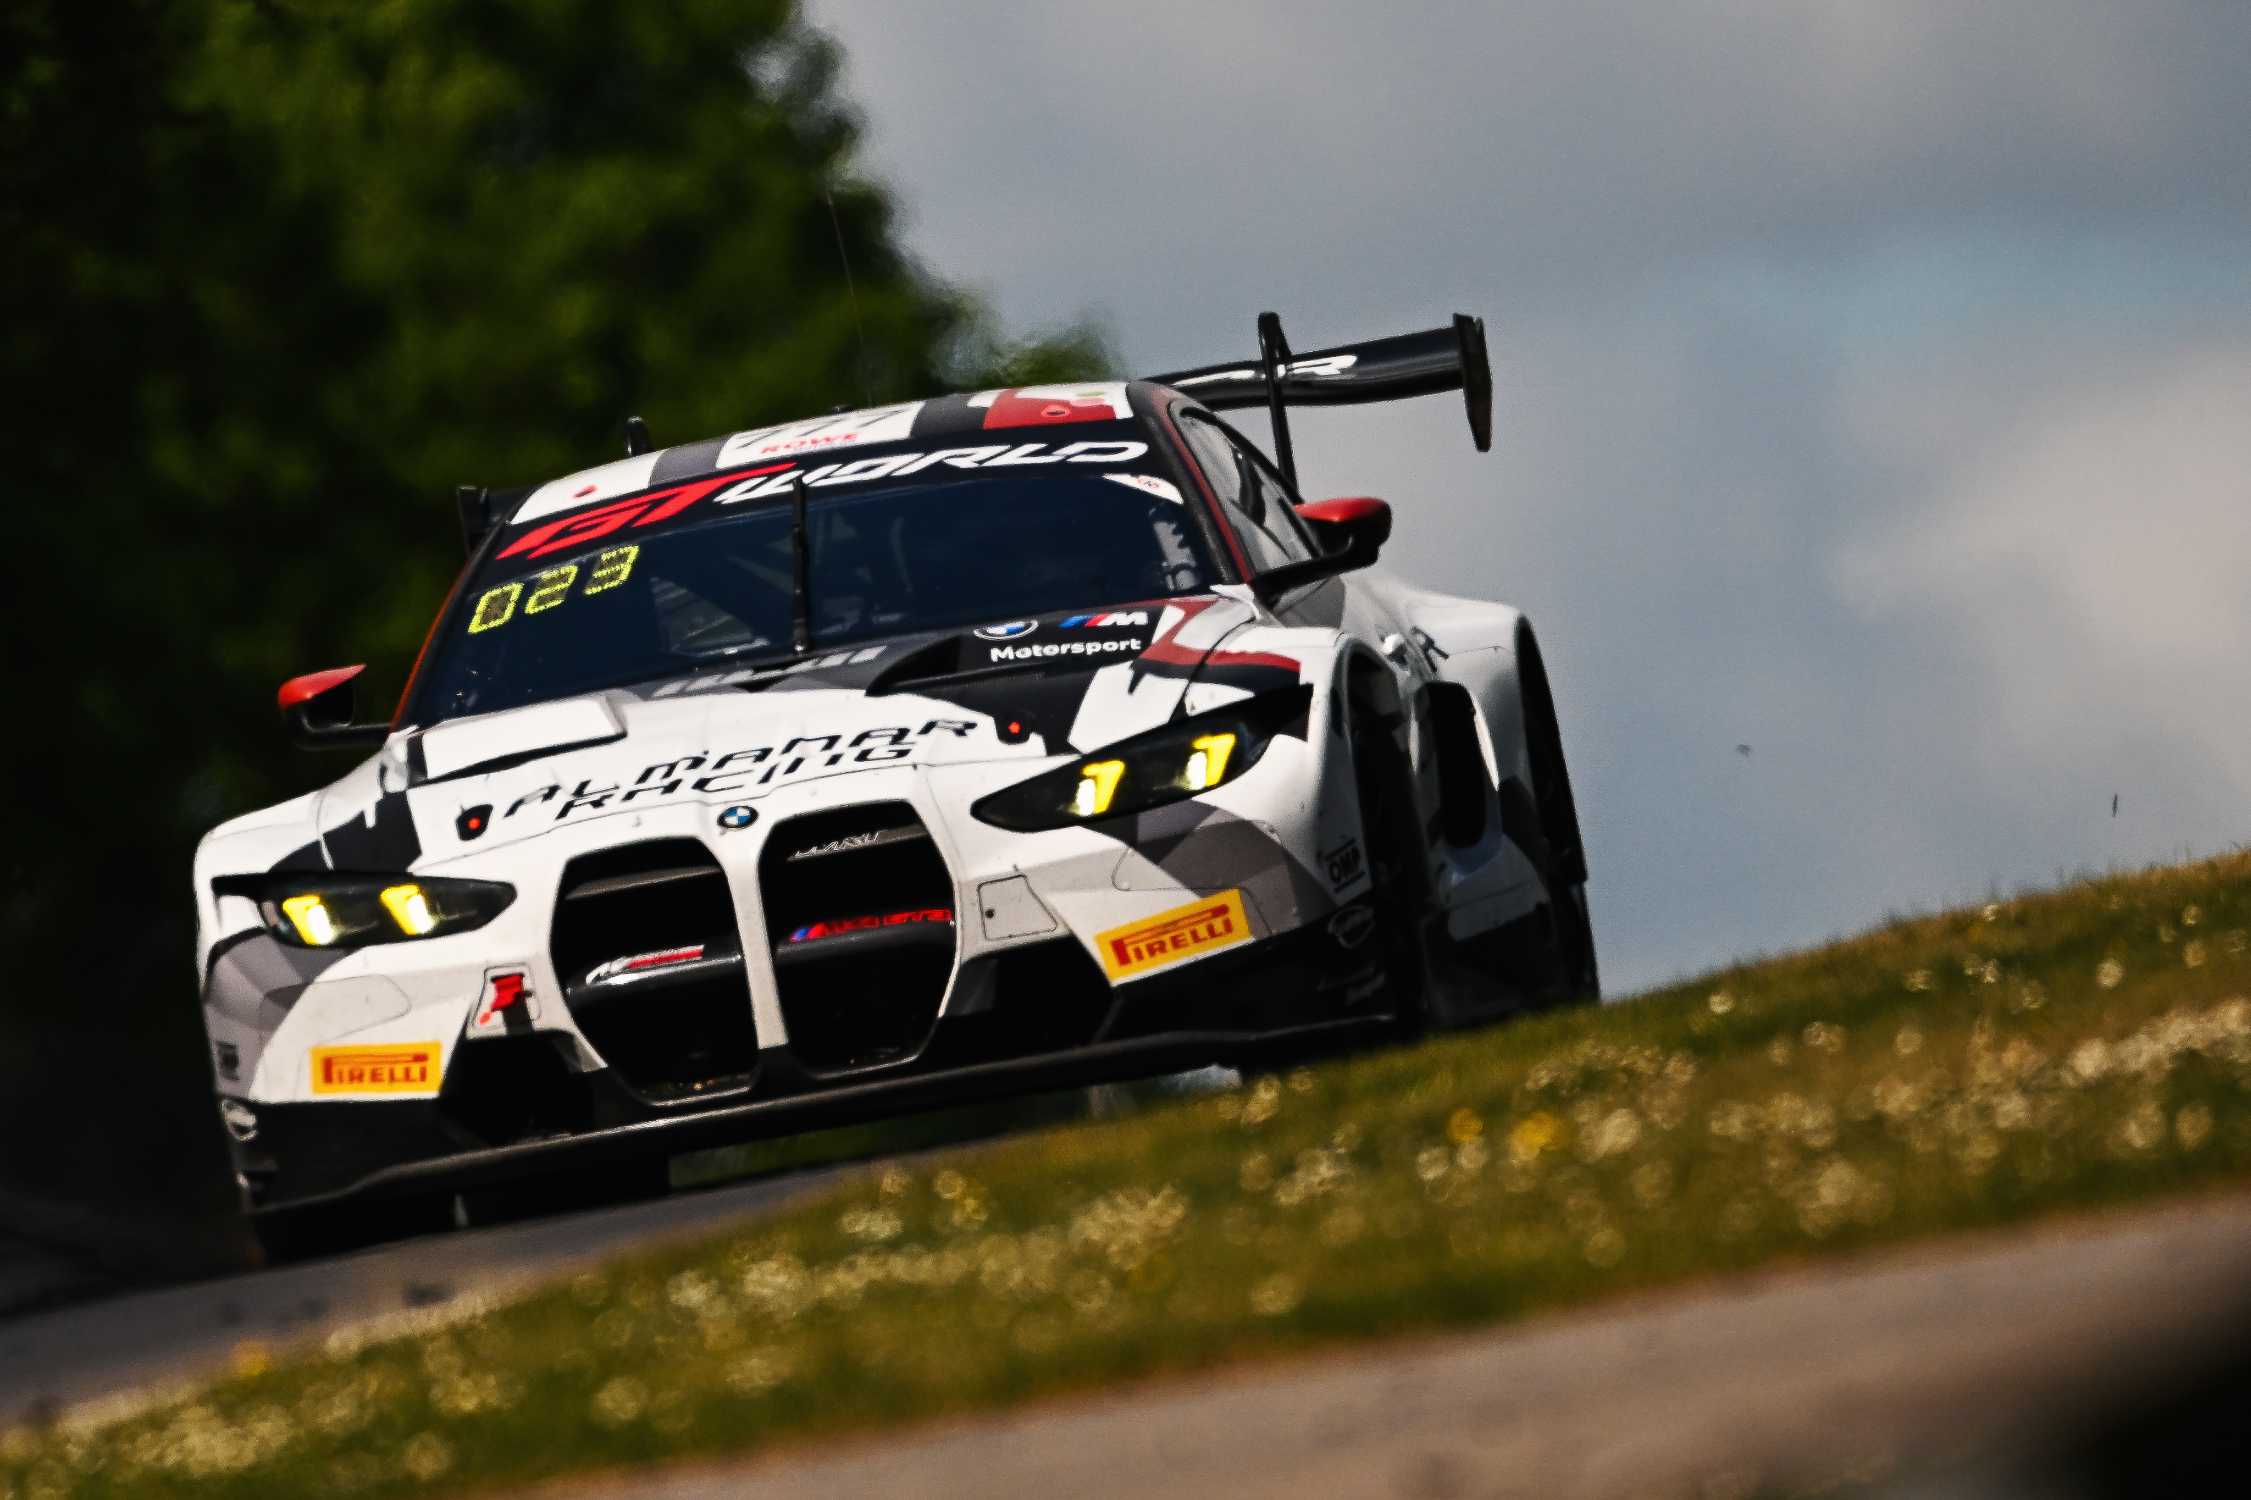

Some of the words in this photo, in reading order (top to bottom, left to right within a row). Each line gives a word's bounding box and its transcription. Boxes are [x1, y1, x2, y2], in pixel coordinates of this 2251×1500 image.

[467, 545, 639, 634] 023
[990, 638, 1142, 662] Motorsport
[555, 747, 912, 820] RACING
[1110, 903, 1234, 966] PIRELLI
[323, 1053, 429, 1084] PIRELLI
